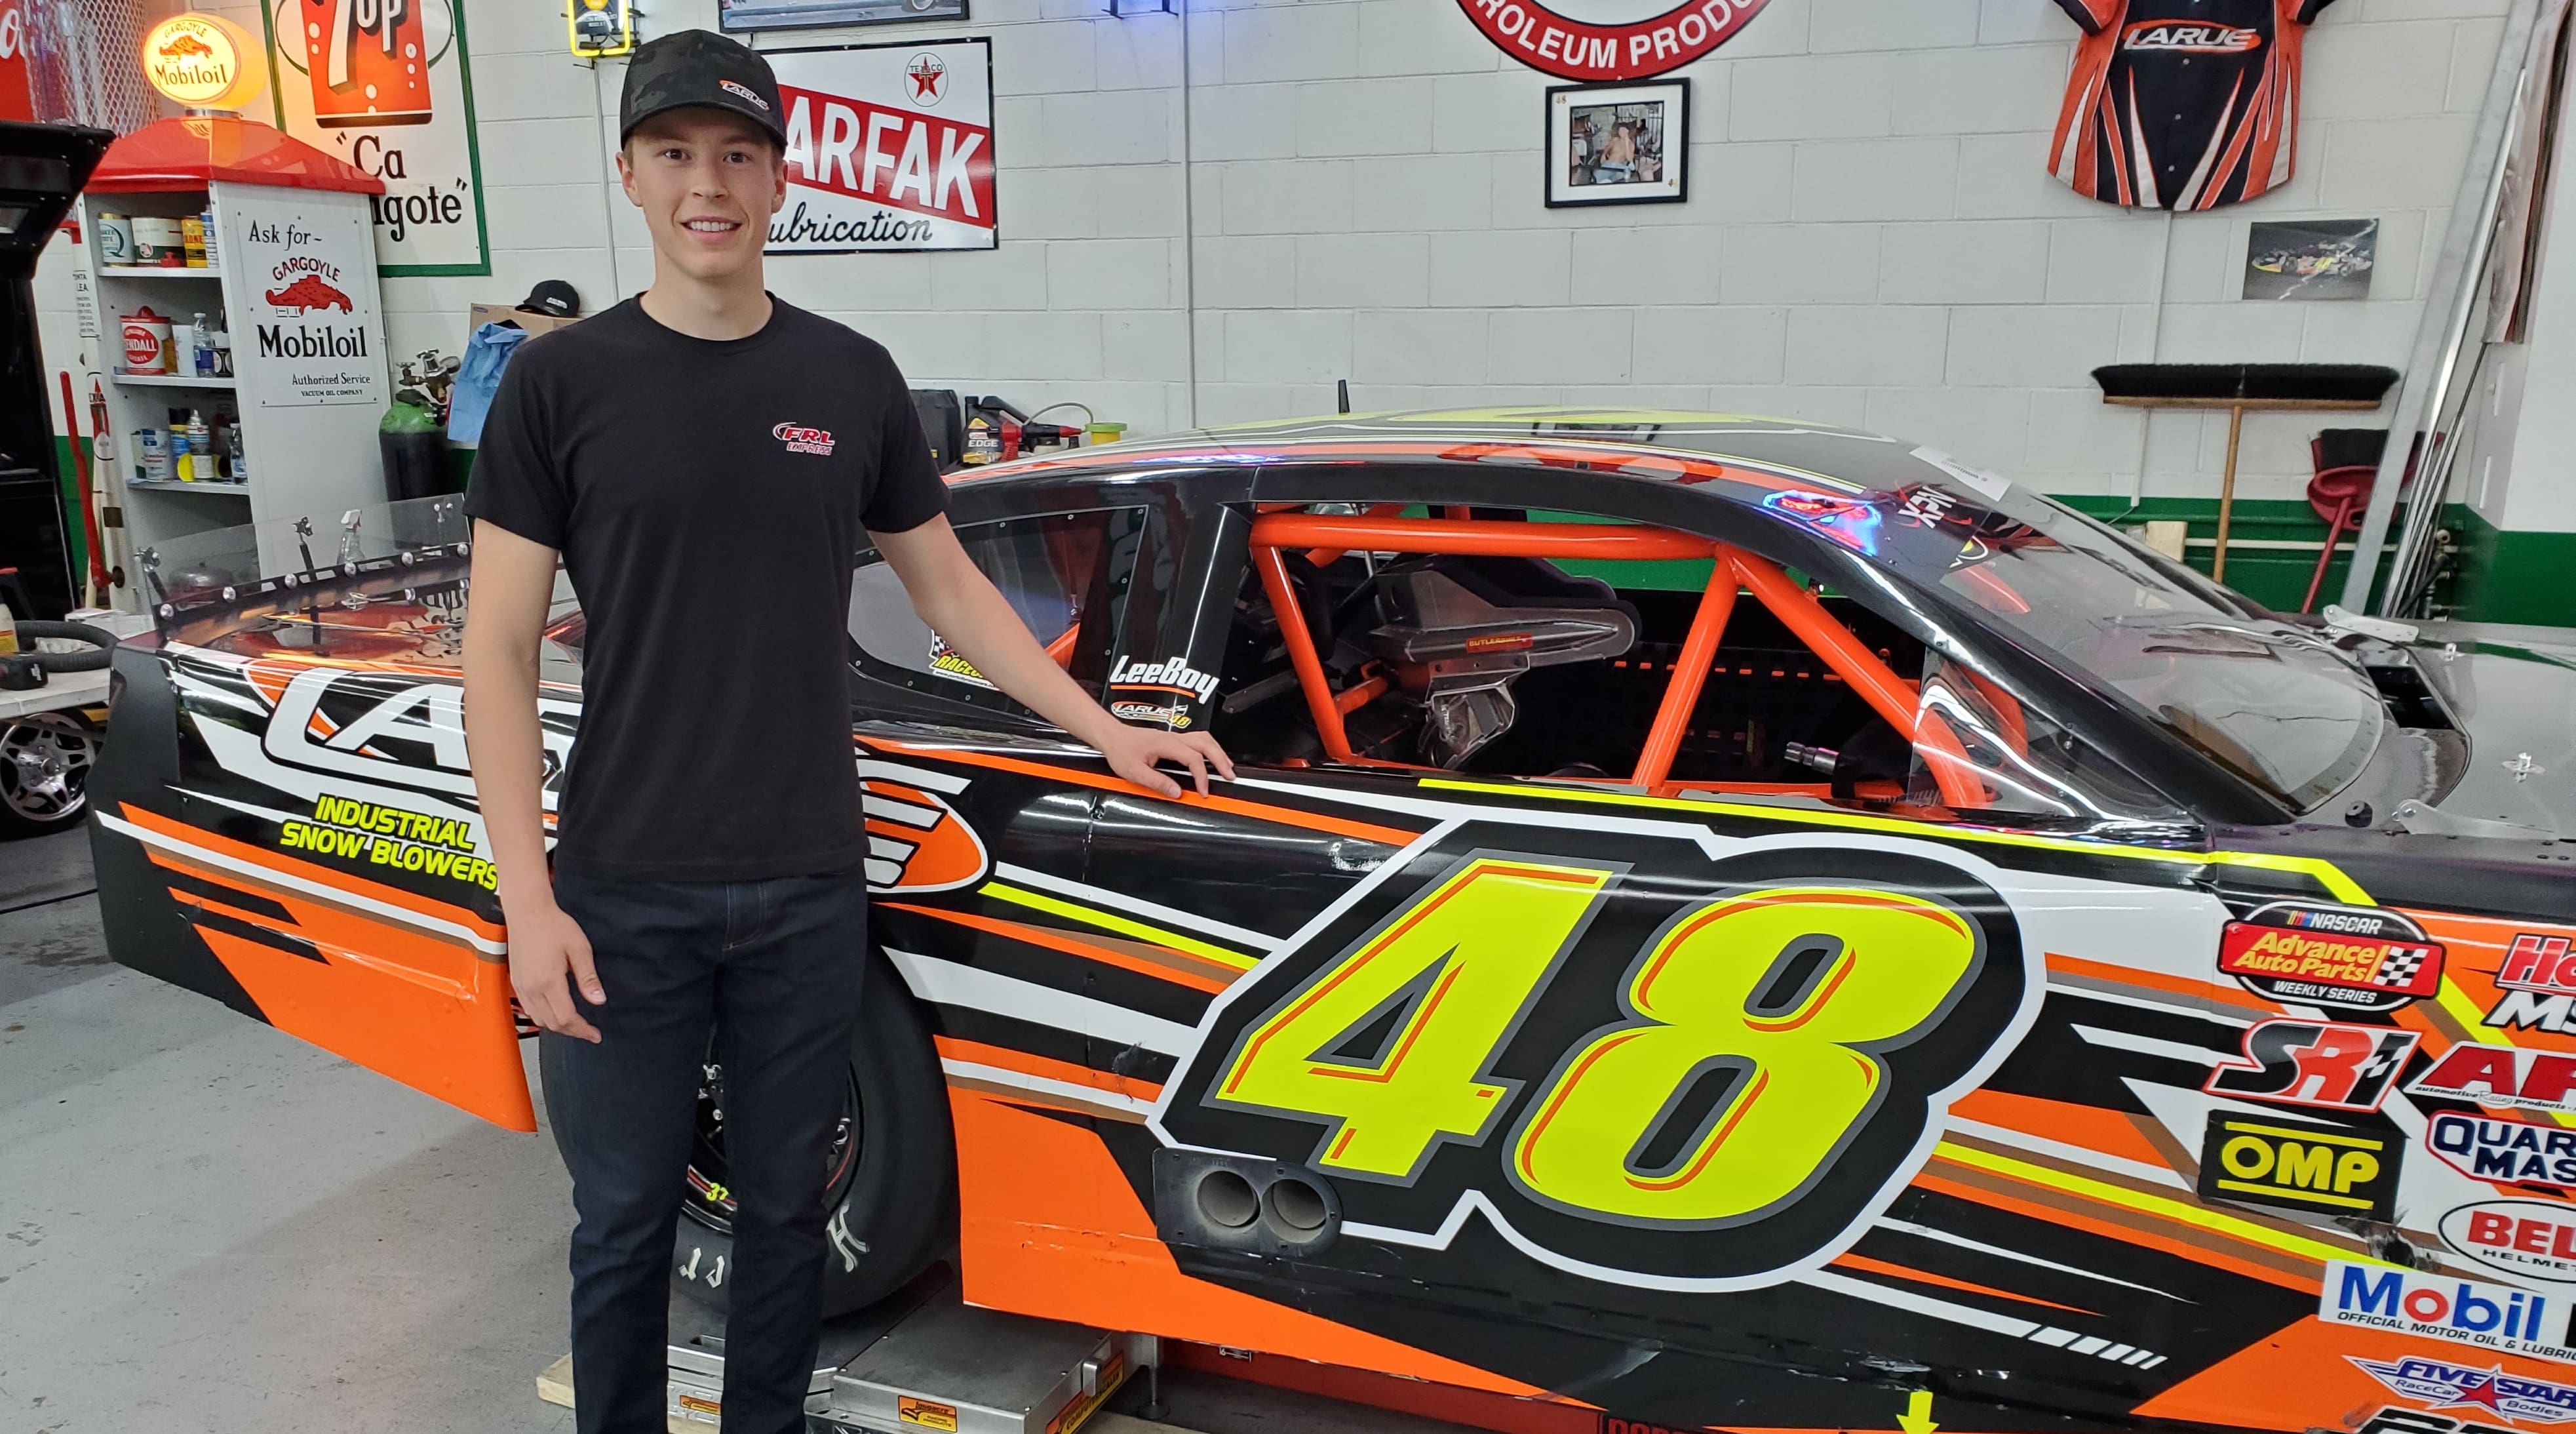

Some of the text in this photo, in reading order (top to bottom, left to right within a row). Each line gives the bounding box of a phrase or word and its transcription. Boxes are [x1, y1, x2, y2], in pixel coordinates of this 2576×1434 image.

[164, 22, 208, 38] GARGOYLE
[2124, 28, 2257, 50] LARUE
[155, 64, 227, 87] Mobiloil
[910, 64, 943, 72] TEXACO
[784, 96, 986, 218] ARFAK
[248, 220, 281, 243] Ask
[767, 201, 933, 243] ubrication
[272, 256, 341, 282] GARGOYLE
[256, 324, 368, 358] Mobiloil
[291, 372, 371, 386] Authorized Service
[783, 428, 836, 446] FRL
[787, 442, 832, 456] EXPRESS
[1109, 655, 1220, 705] LeeBoy
[314, 796, 476, 850] INDUSTRIAL
[280, 822, 498, 890] SNOW BLOWERS
[2309, 912, 2383, 935] NASCAR
[2249, 932, 2376, 964] Advance
[2233, 951, 2368, 982] Auto Parts
[2273, 980, 2377, 1004] WEEKLY SERIES
[1205, 850, 1983, 1228] 48
[2415, 1086, 2478, 1098] automotive
[2514, 1098, 2566, 1110] products
[2221, 1136, 2380, 1194] OMP
[2338, 1265, 2546, 1342] Mobil
[2337, 1311, 2405, 1330] OFFICIAL
[2410, 1322, 2469, 1341] MOTOR
[2474, 1333, 2499, 1346] OIL
[2505, 1339, 2517, 1349] &
[2394, 1379, 2459, 1397] RaceCar
[2397, 1361, 2576, 1410] FIVE STAR
[2506, 1400, 2564, 1417] Bodies
